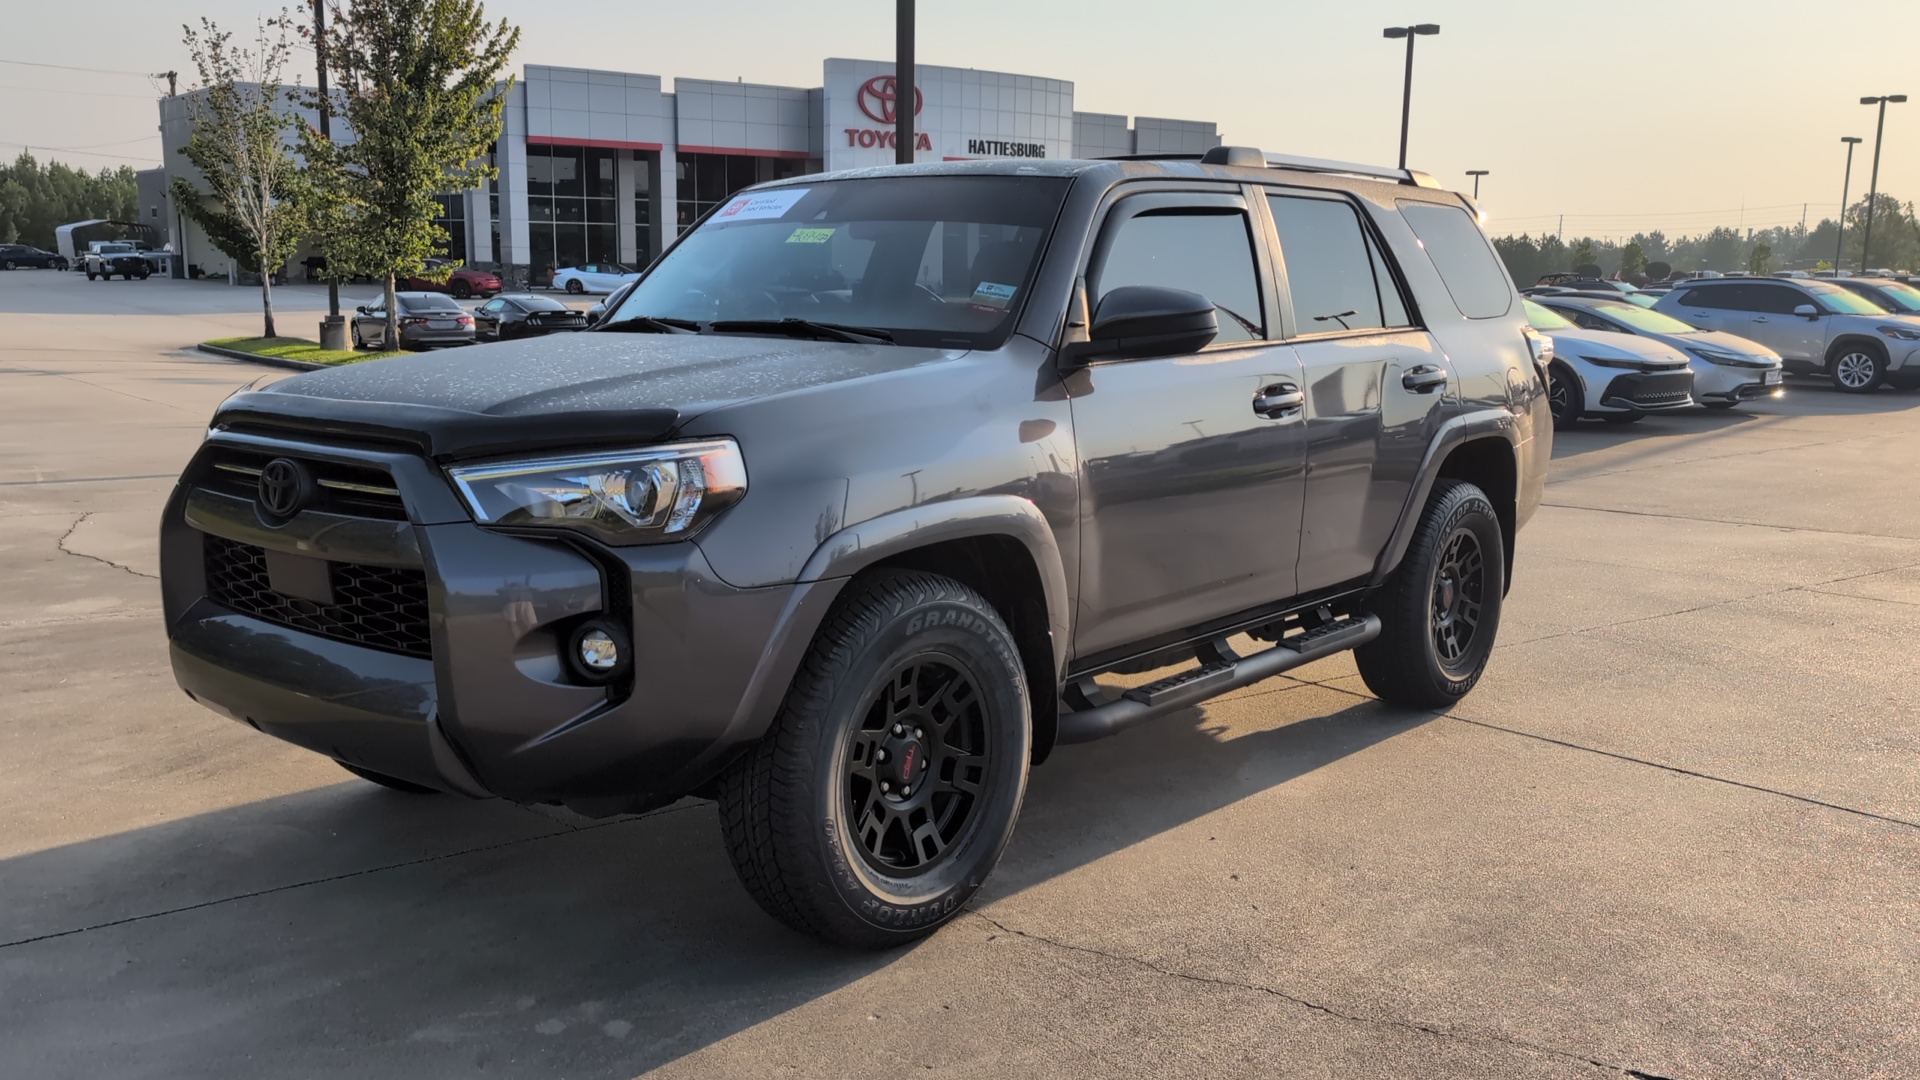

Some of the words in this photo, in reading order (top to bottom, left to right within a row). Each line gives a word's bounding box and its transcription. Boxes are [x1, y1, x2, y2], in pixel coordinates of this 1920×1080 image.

[844, 128, 932, 151] TOYA
[968, 139, 1046, 159] HATTIESBURG
[903, 745, 916, 779] TRD
[860, 896, 957, 926] DUNLOP
